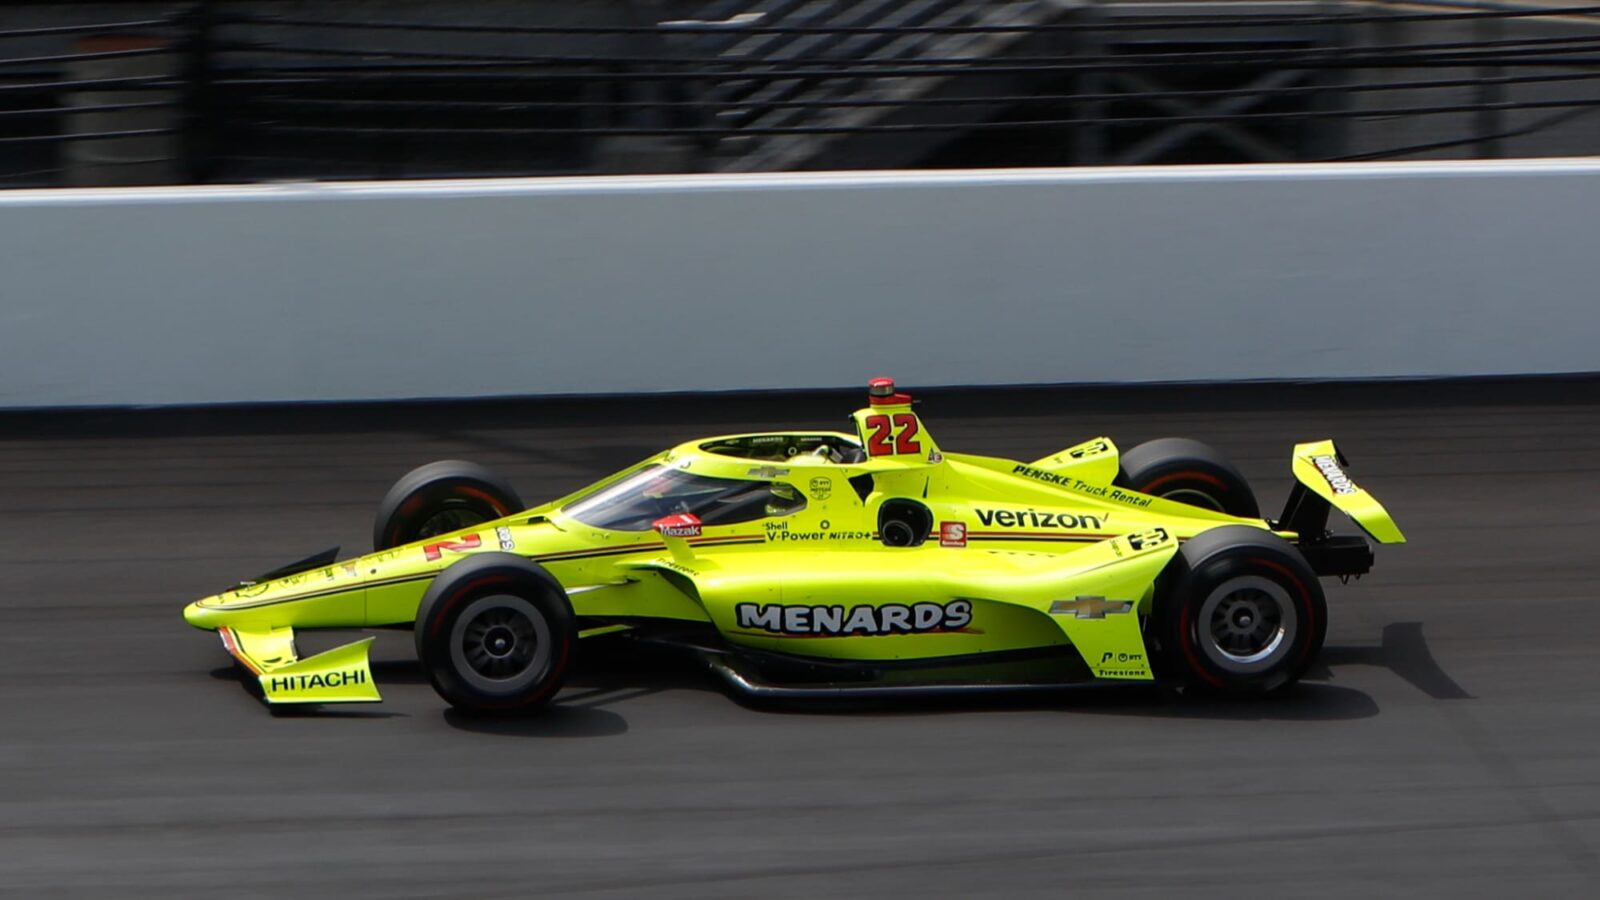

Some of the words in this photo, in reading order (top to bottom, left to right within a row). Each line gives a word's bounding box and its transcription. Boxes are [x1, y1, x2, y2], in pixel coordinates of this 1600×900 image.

[866, 413, 921, 457] 22
[1309, 454, 1358, 495] MENARDS
[1012, 464, 1072, 487] PENSKE
[1073, 480, 1108, 497] Truck
[1109, 489, 1153, 508] Rental
[659, 524, 701, 536] Mazak
[765, 522, 788, 531] Shell
[975, 508, 1102, 530] verizon
[767, 531, 825, 541] V-Power
[735, 601, 973, 635] MENARDS
[271, 669, 365, 692] HITACHI
[1099, 669, 1146, 677] Firestone
